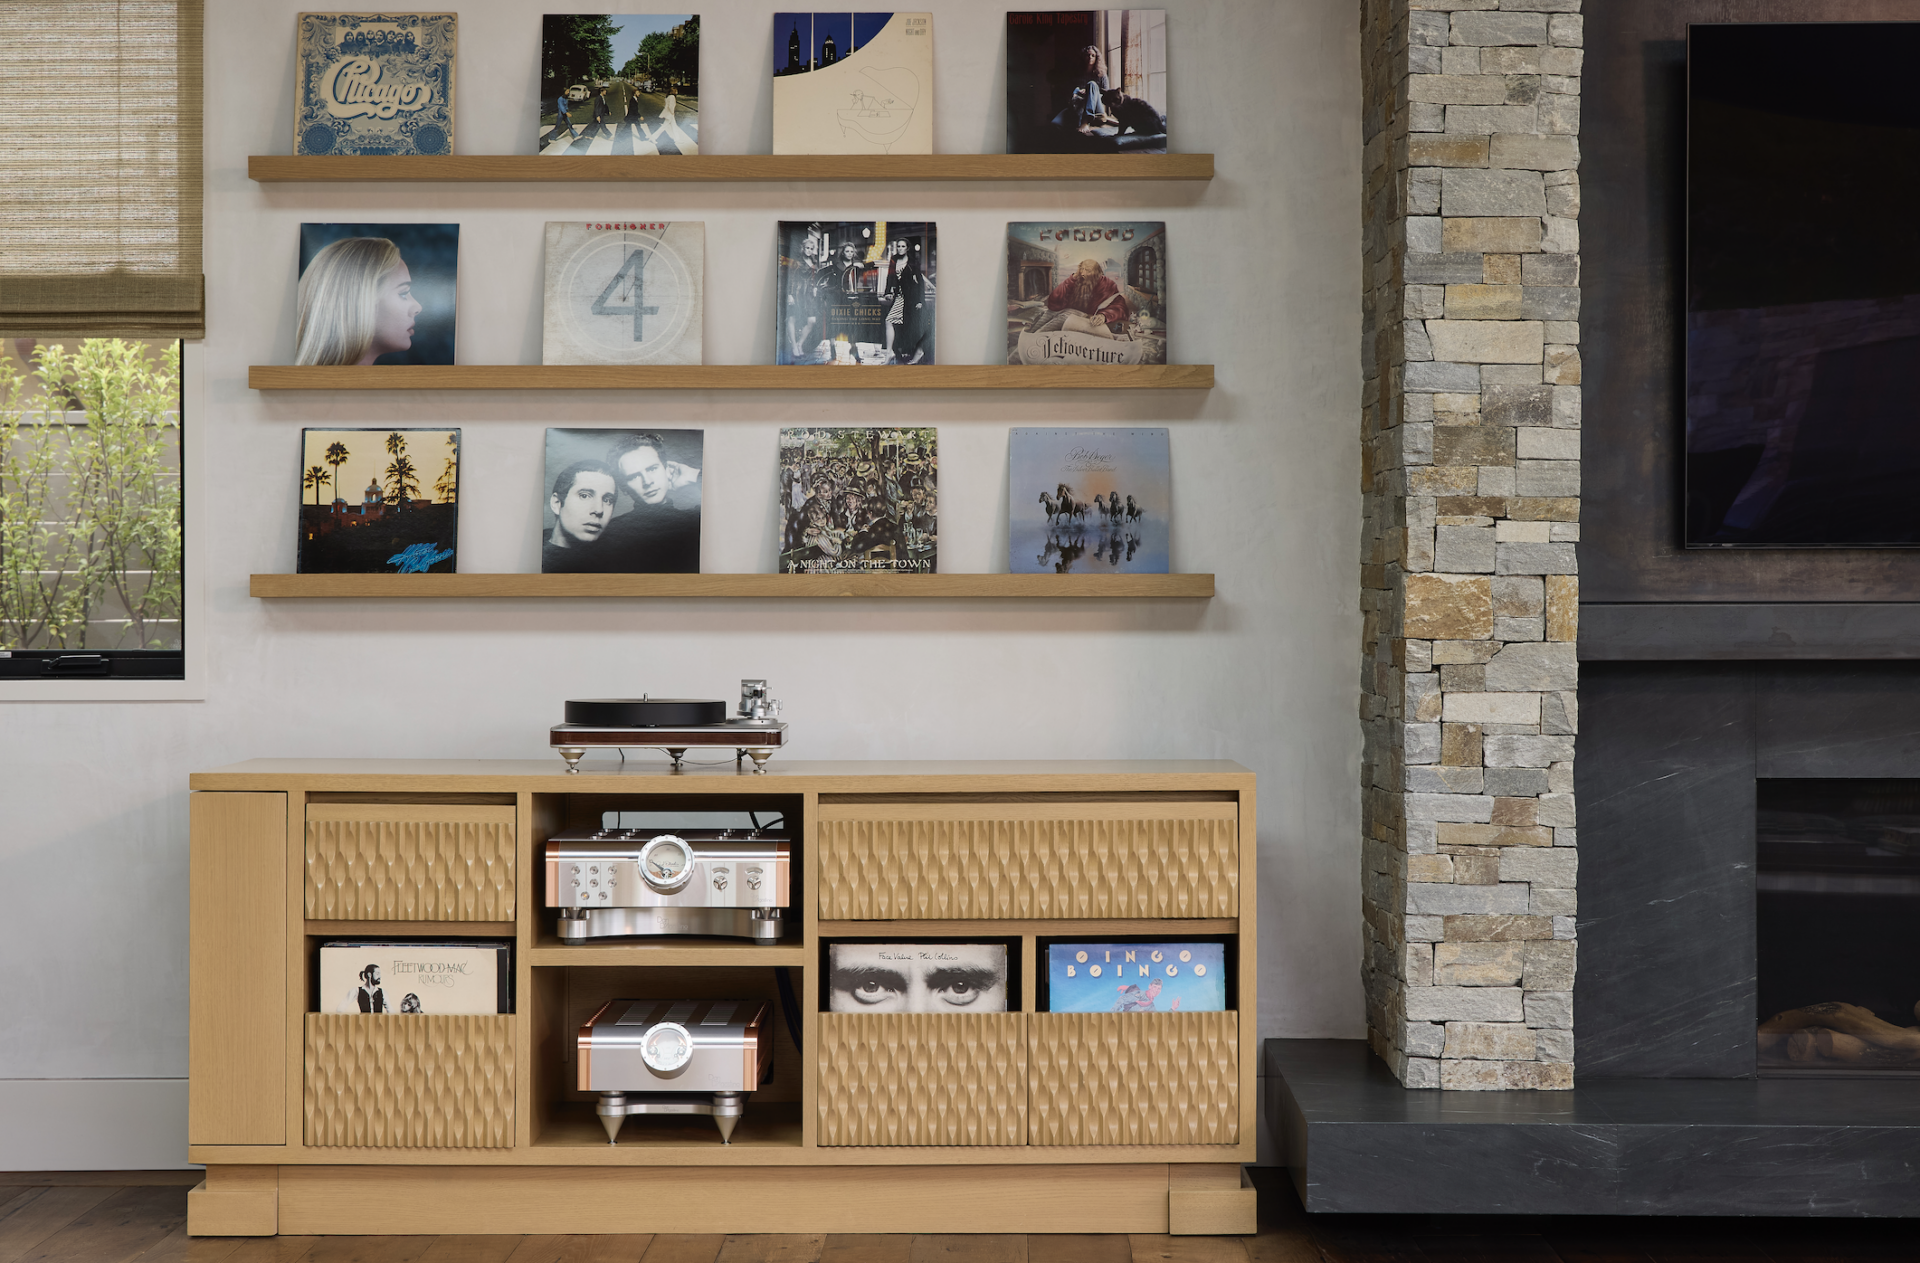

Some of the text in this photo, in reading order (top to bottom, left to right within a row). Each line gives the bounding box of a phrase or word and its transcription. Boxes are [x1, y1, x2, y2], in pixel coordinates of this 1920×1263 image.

[1009, 12, 1088, 26] Carole King Tapestry
[320, 56, 433, 120] Chicago
[586, 223, 665, 231] FOREIGNER
[1039, 228, 1135, 242] KANSAS
[590, 249, 660, 342] 4
[831, 308, 882, 316] DIXIE CHICKS
[1036, 335, 1124, 364] Leftoverture
[787, 430, 930, 439] ROD STEWART
[787, 559, 931, 569] A NIGHT ON THE TOWN
[879, 951, 893, 960] Face
[894, 952, 914, 960] Value
[918, 951, 933, 960] Phil
[1076, 950, 1192, 963] OINGO
[391, 960, 474, 975] FLEETWOOD MAC
[1067, 963, 1207, 977] BOINGO
[418, 974, 455, 988] RUMOURS
